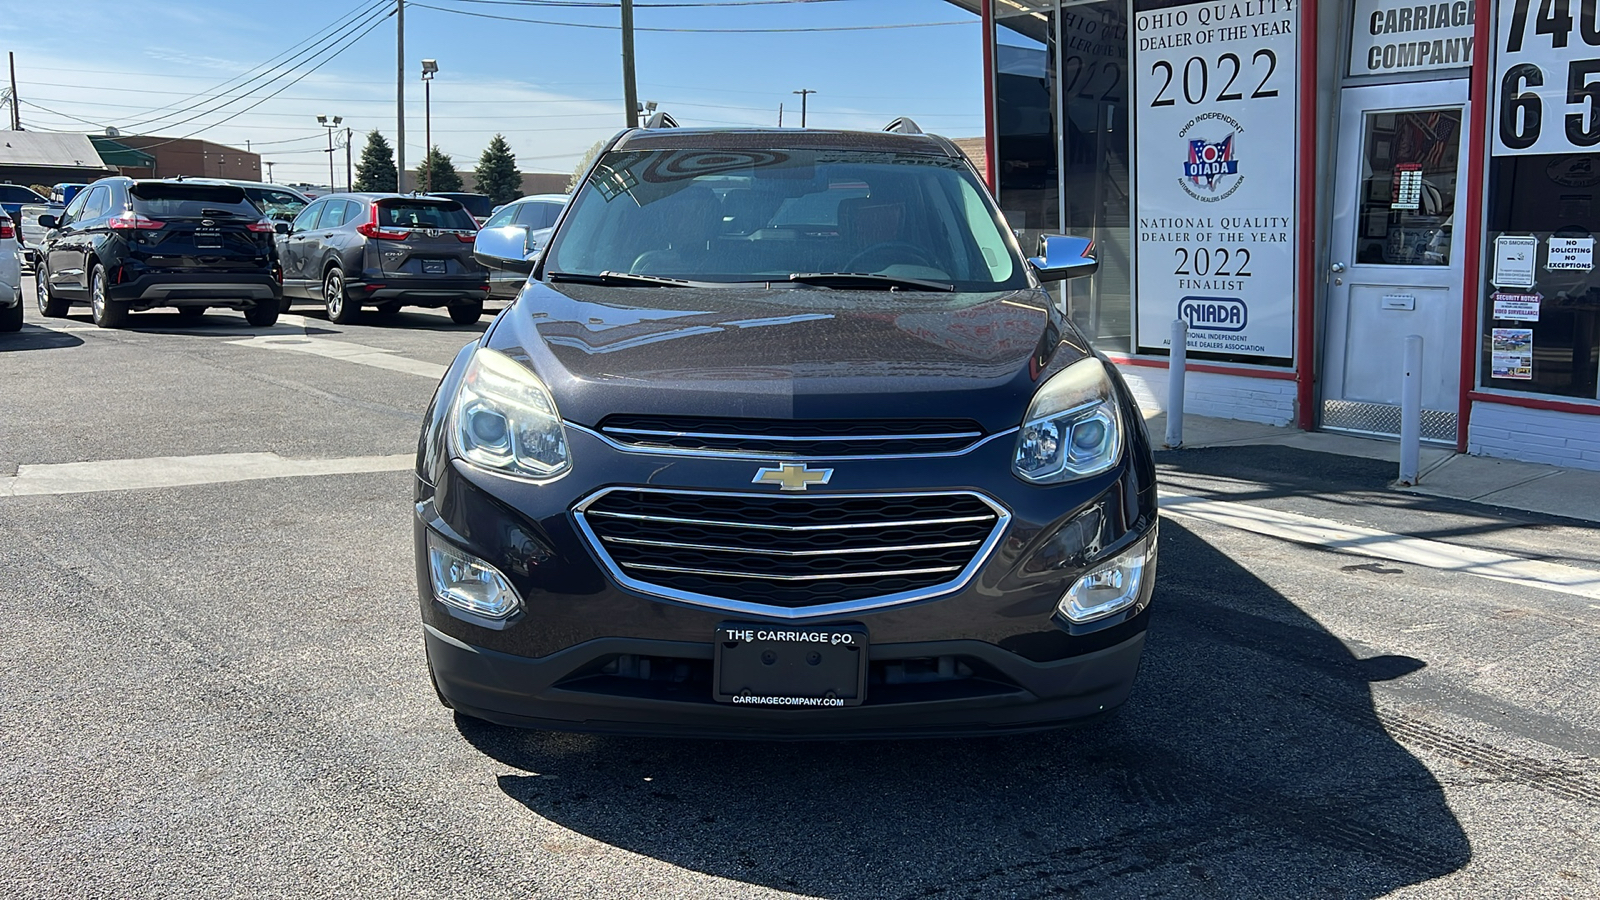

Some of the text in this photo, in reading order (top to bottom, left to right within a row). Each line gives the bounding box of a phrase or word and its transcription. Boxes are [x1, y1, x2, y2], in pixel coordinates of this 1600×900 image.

[1137, 0, 1293, 31] OHIO QUALITY
[1139, 32, 1192, 51] DEALER
[1196, 30, 1214, 44] OF
[1218, 26, 1247, 42] THE
[1251, 19, 1292, 37] YEAR
[1367, 37, 1474, 70] COMPANY
[1150, 48, 1279, 107] 2022
[1178, 112, 1244, 138] OHIO INDEPENDENT
[1190, 162, 1229, 175] OIADA
[1177, 177, 1200, 200] AUTOMOBILE
[1220, 175, 1245, 200] ASSOCIATION
[1140, 217, 1290, 230] NATIONAL QUALITY
[1141, 232, 1288, 243] DEALER OF THE YEAR
[1174, 247, 1252, 277] 2022
[1179, 279, 1245, 291] FINALIST
[1183, 303, 1241, 324] NIADA
[1207, 333, 1247, 341] INDEPENDENT
[1225, 343, 1265, 351] ASSOCIATION
[726, 629, 855, 644] THE CARRIAGE CO.
[732, 695, 844, 706] CARRIAGECOMPANY.COM
